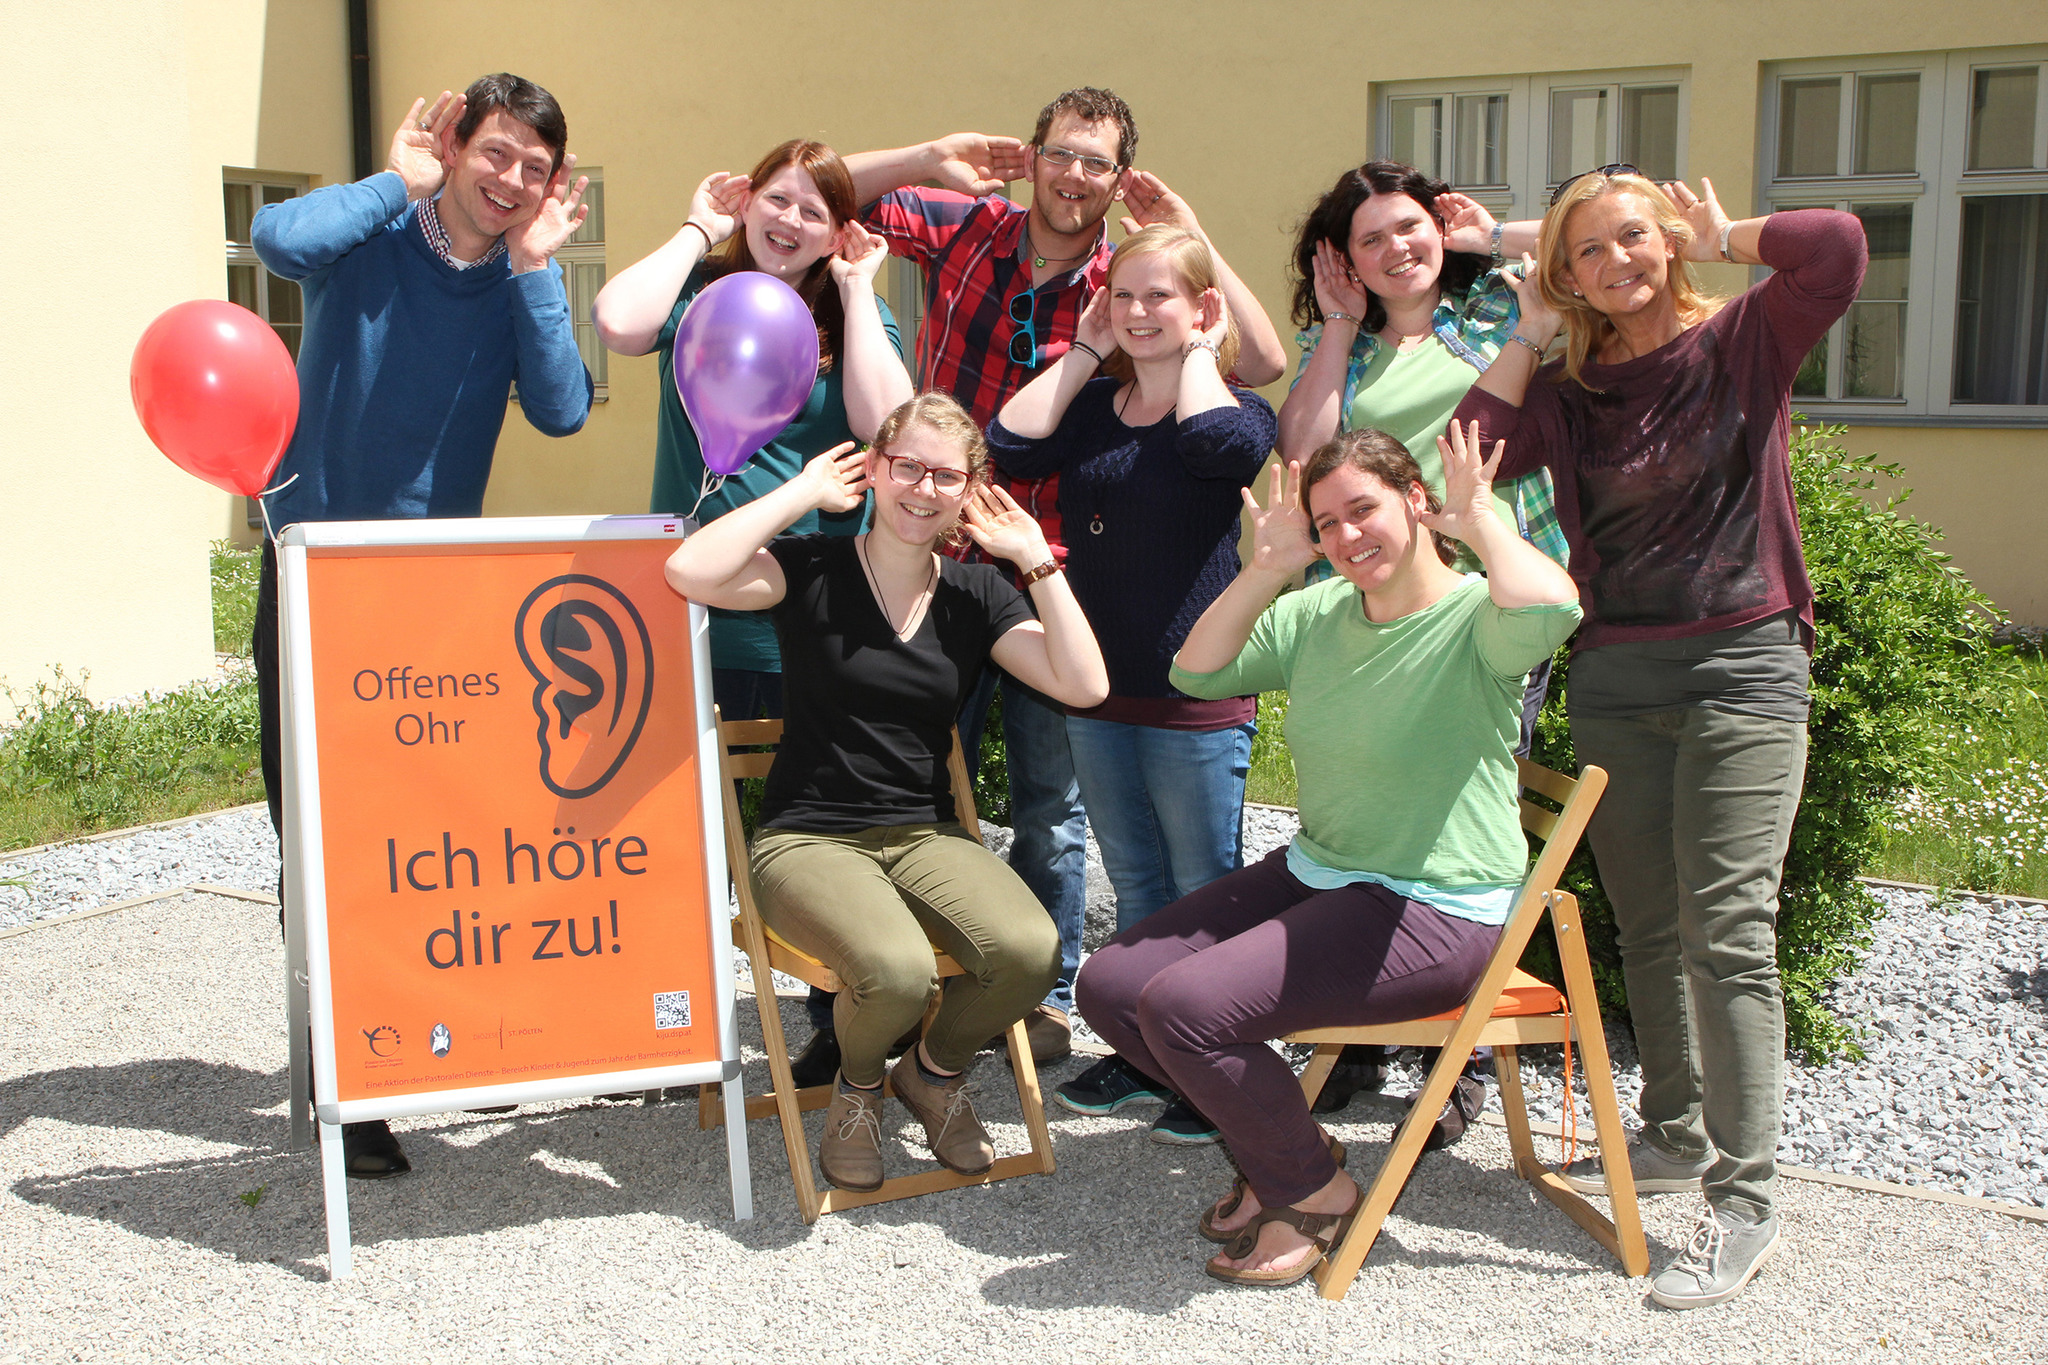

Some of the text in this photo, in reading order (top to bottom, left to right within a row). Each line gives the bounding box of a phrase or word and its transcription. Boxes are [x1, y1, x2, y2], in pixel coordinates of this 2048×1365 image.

[354, 666, 500, 702] Offenes
[395, 711, 466, 746] Ohr
[387, 826, 648, 893] Ich höre
[426, 900, 622, 970] dir zu!
[518, 1028, 543, 1036] PÖLTEN
[656, 1030, 692, 1039] kiju.dsp.at
[365, 1081, 383, 1089] Eine
[384, 1078, 409, 1087] Aktion
[425, 1073, 465, 1082] Pastoralen
[465, 1069, 494, 1078] Dienste
[501, 1065, 529, 1074] Bereich
[530, 1062, 555, 1071] Kinder
[562, 1059, 590, 1069] Jugend
[608, 1056, 624, 1064] Jahr
[624, 1054, 637, 1062] der
[638, 1048, 693, 1060] Barmherzigkeit.
